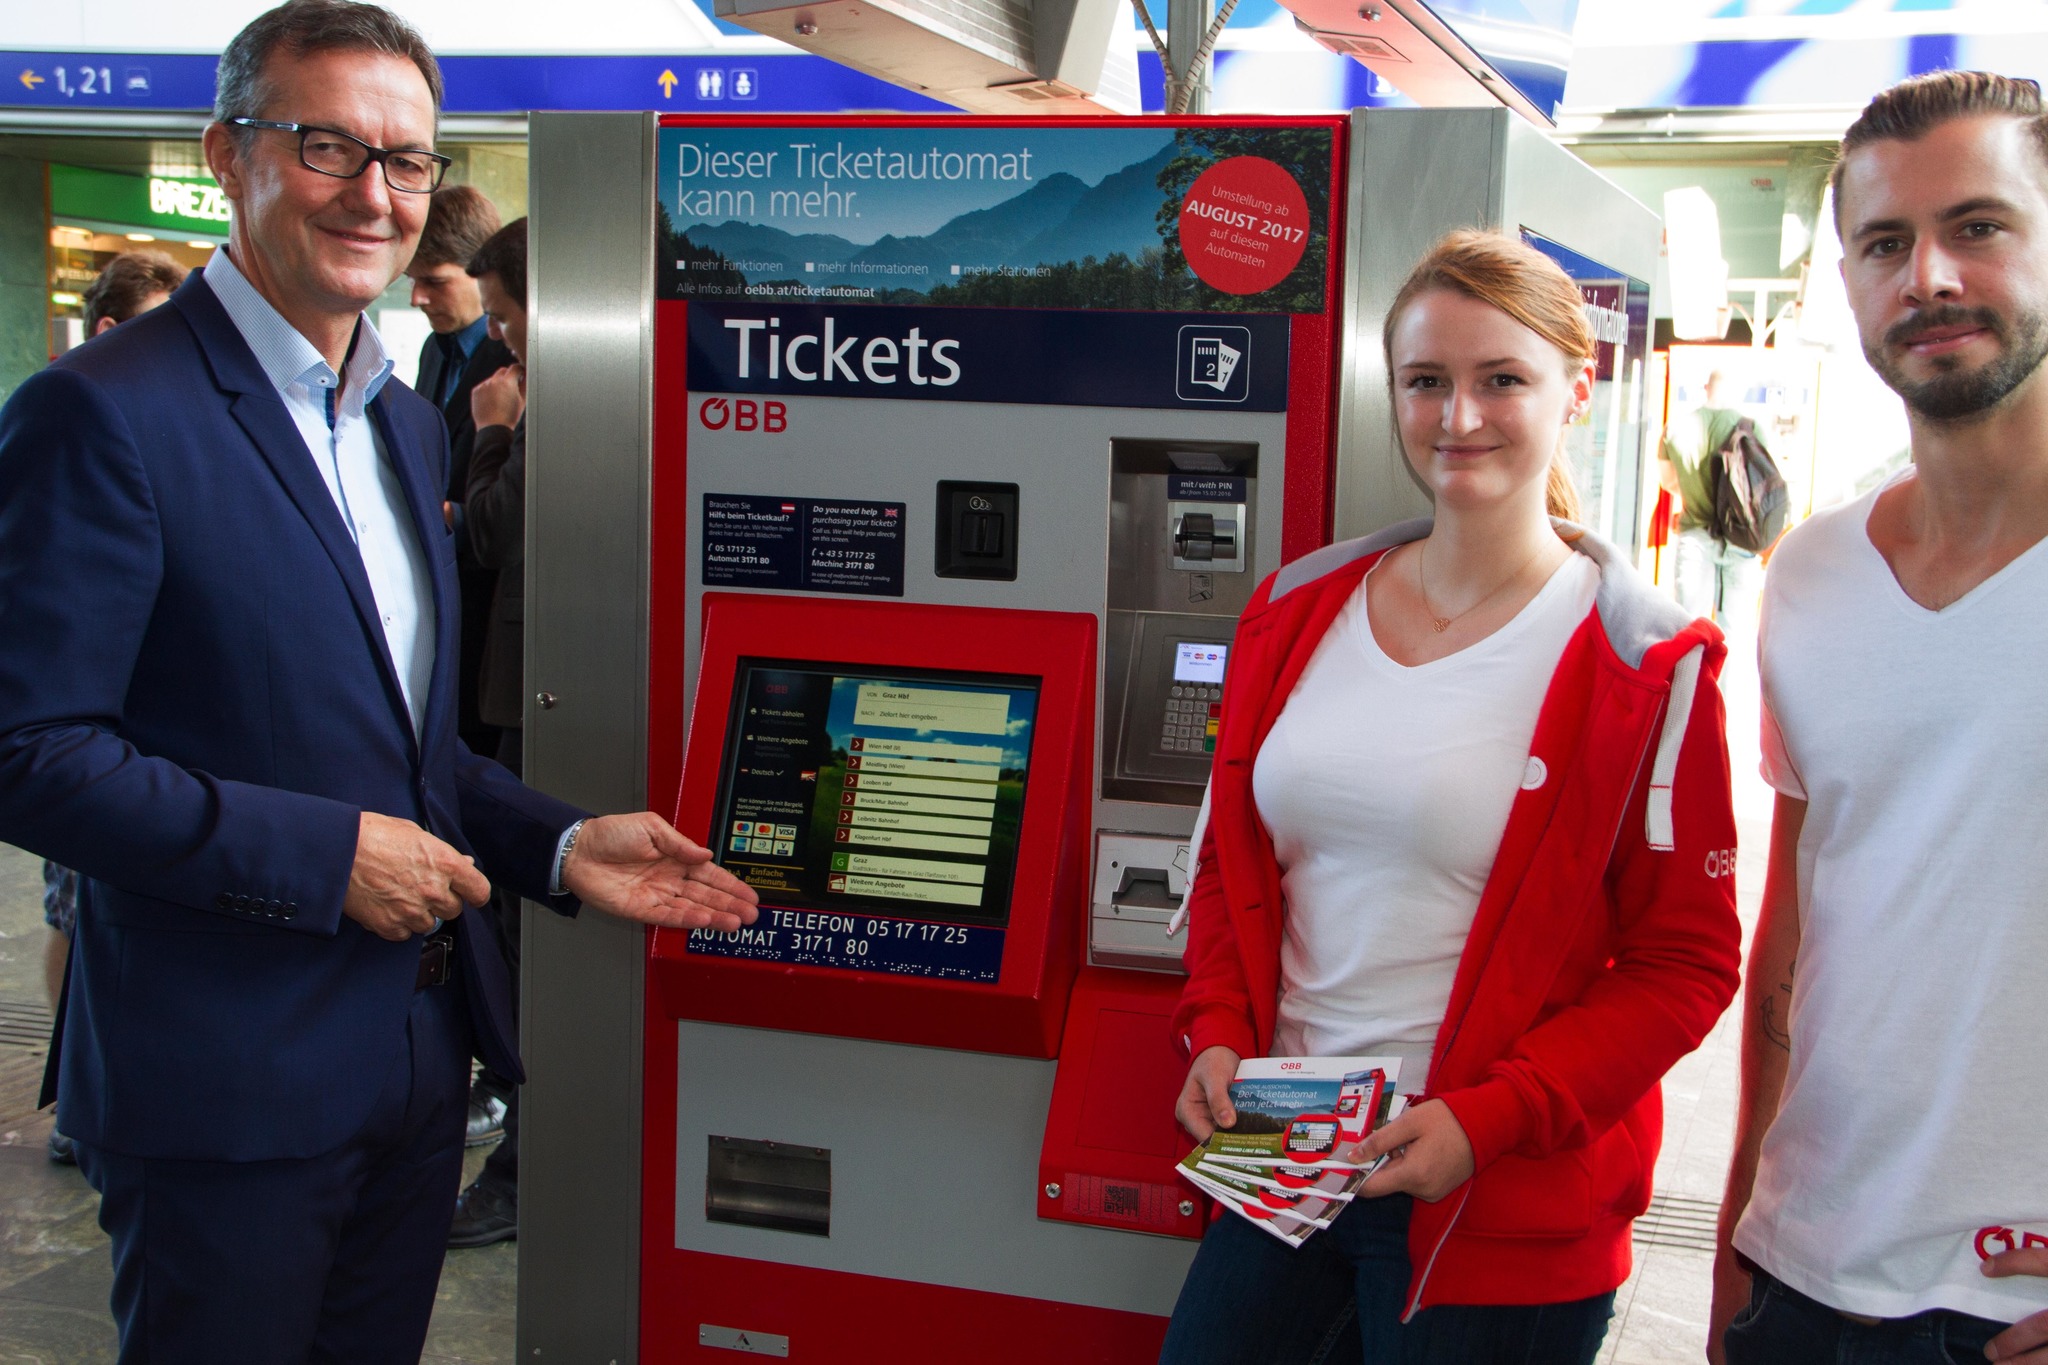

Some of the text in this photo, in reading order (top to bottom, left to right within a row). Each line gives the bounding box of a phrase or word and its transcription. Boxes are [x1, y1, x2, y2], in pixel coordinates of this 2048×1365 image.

[678, 142, 1032, 180] Dieser Ticketautomat
[677, 180, 861, 218] kann mehr.
[1212, 185, 1289, 216] Umstellung ab
[1185, 200, 1304, 244] AUGUST 2017
[1209, 227, 1269, 251] auf diesem
[1204, 242, 1265, 268] Automaten
[691, 260, 783, 272] mehr Funktionen
[818, 261, 928, 275] mehr Informationen
[964, 264, 1051, 277] mehr Stationen
[677, 283, 875, 298] Alle Infos auf oebb.at/ticketautomat
[724, 317, 961, 386] Tickets
[1206, 363, 1215, 376] 2
[700, 397, 787, 433] ÖBB
[709, 501, 740, 509] Brauchen
[747, 513, 789, 521] Ticketkauf?
[861, 508, 877, 516] help
[812, 517, 897, 527] purchasing your tickets?
[727, 545, 745, 553] 1717
[845, 551, 864, 559] 1717
[708, 554, 739, 563] Automat
[741, 556, 757, 564] 3171
[812, 560, 843, 568] Machine
[864, 562, 874, 570] 80
[779, 828, 794, 836] VISA
[751, 868, 784, 877] Einfache
[745, 876, 787, 887] Bedienung
[850, 878, 905, 889] Weitere Angebote
[772, 910, 968, 944] TELEFON 05 17 17 25
[791, 934, 832, 953] 3171
[846, 940, 868, 956] 80
[1238, 1090, 1318, 1099] Der Ticketautomat
[1234, 1099, 1304, 1110] kann jetzt mehr.
